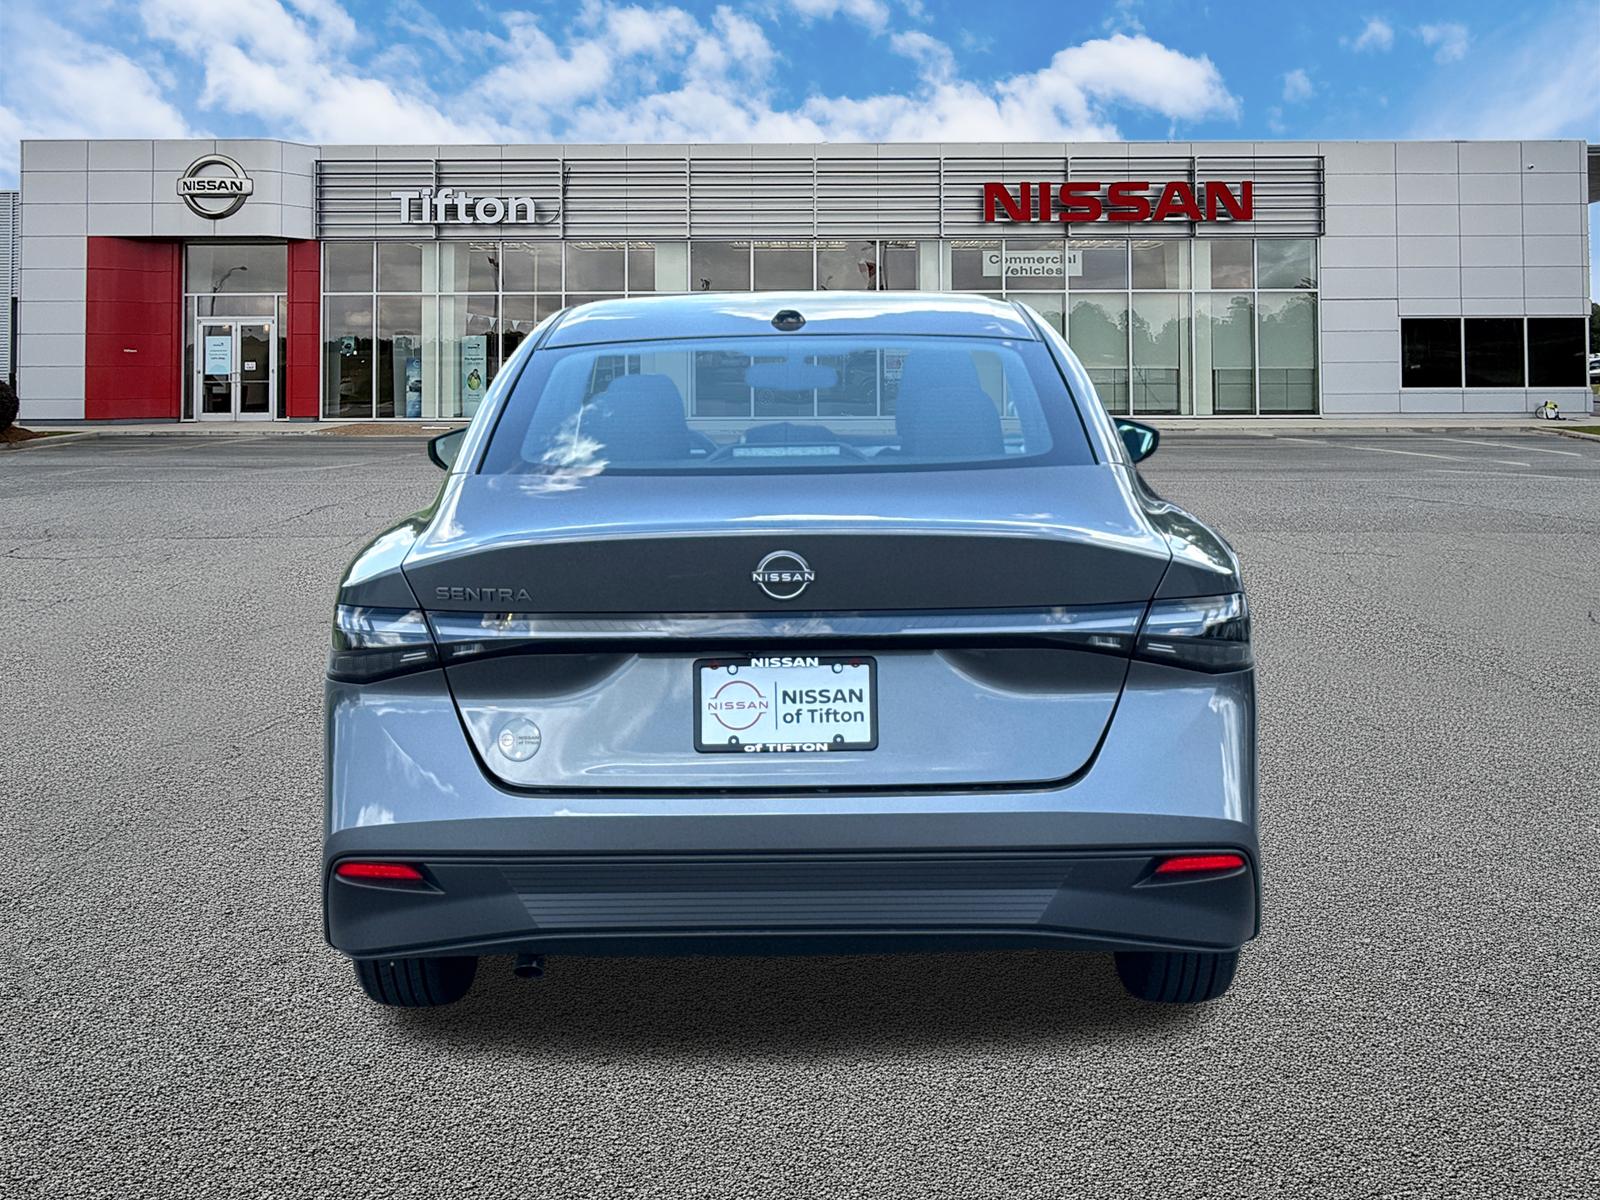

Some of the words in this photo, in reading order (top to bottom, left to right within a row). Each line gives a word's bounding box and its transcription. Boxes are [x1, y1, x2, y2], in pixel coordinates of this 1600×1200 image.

[182, 180, 243, 191] NISSAN
[391, 188, 536, 224] Tifton
[984, 181, 1253, 222] NISSAN
[752, 573, 815, 582] NISSAN
[435, 586, 533, 601] SENTRA
[750, 657, 819, 668] NISSAN
[782, 688, 864, 704] NISSAN
[707, 701, 769, 710] NISSAN
[782, 709, 803, 724] of
[807, 708, 865, 724] Tifton
[743, 743, 763, 753] of
[764, 743, 829, 752] TIFTON
